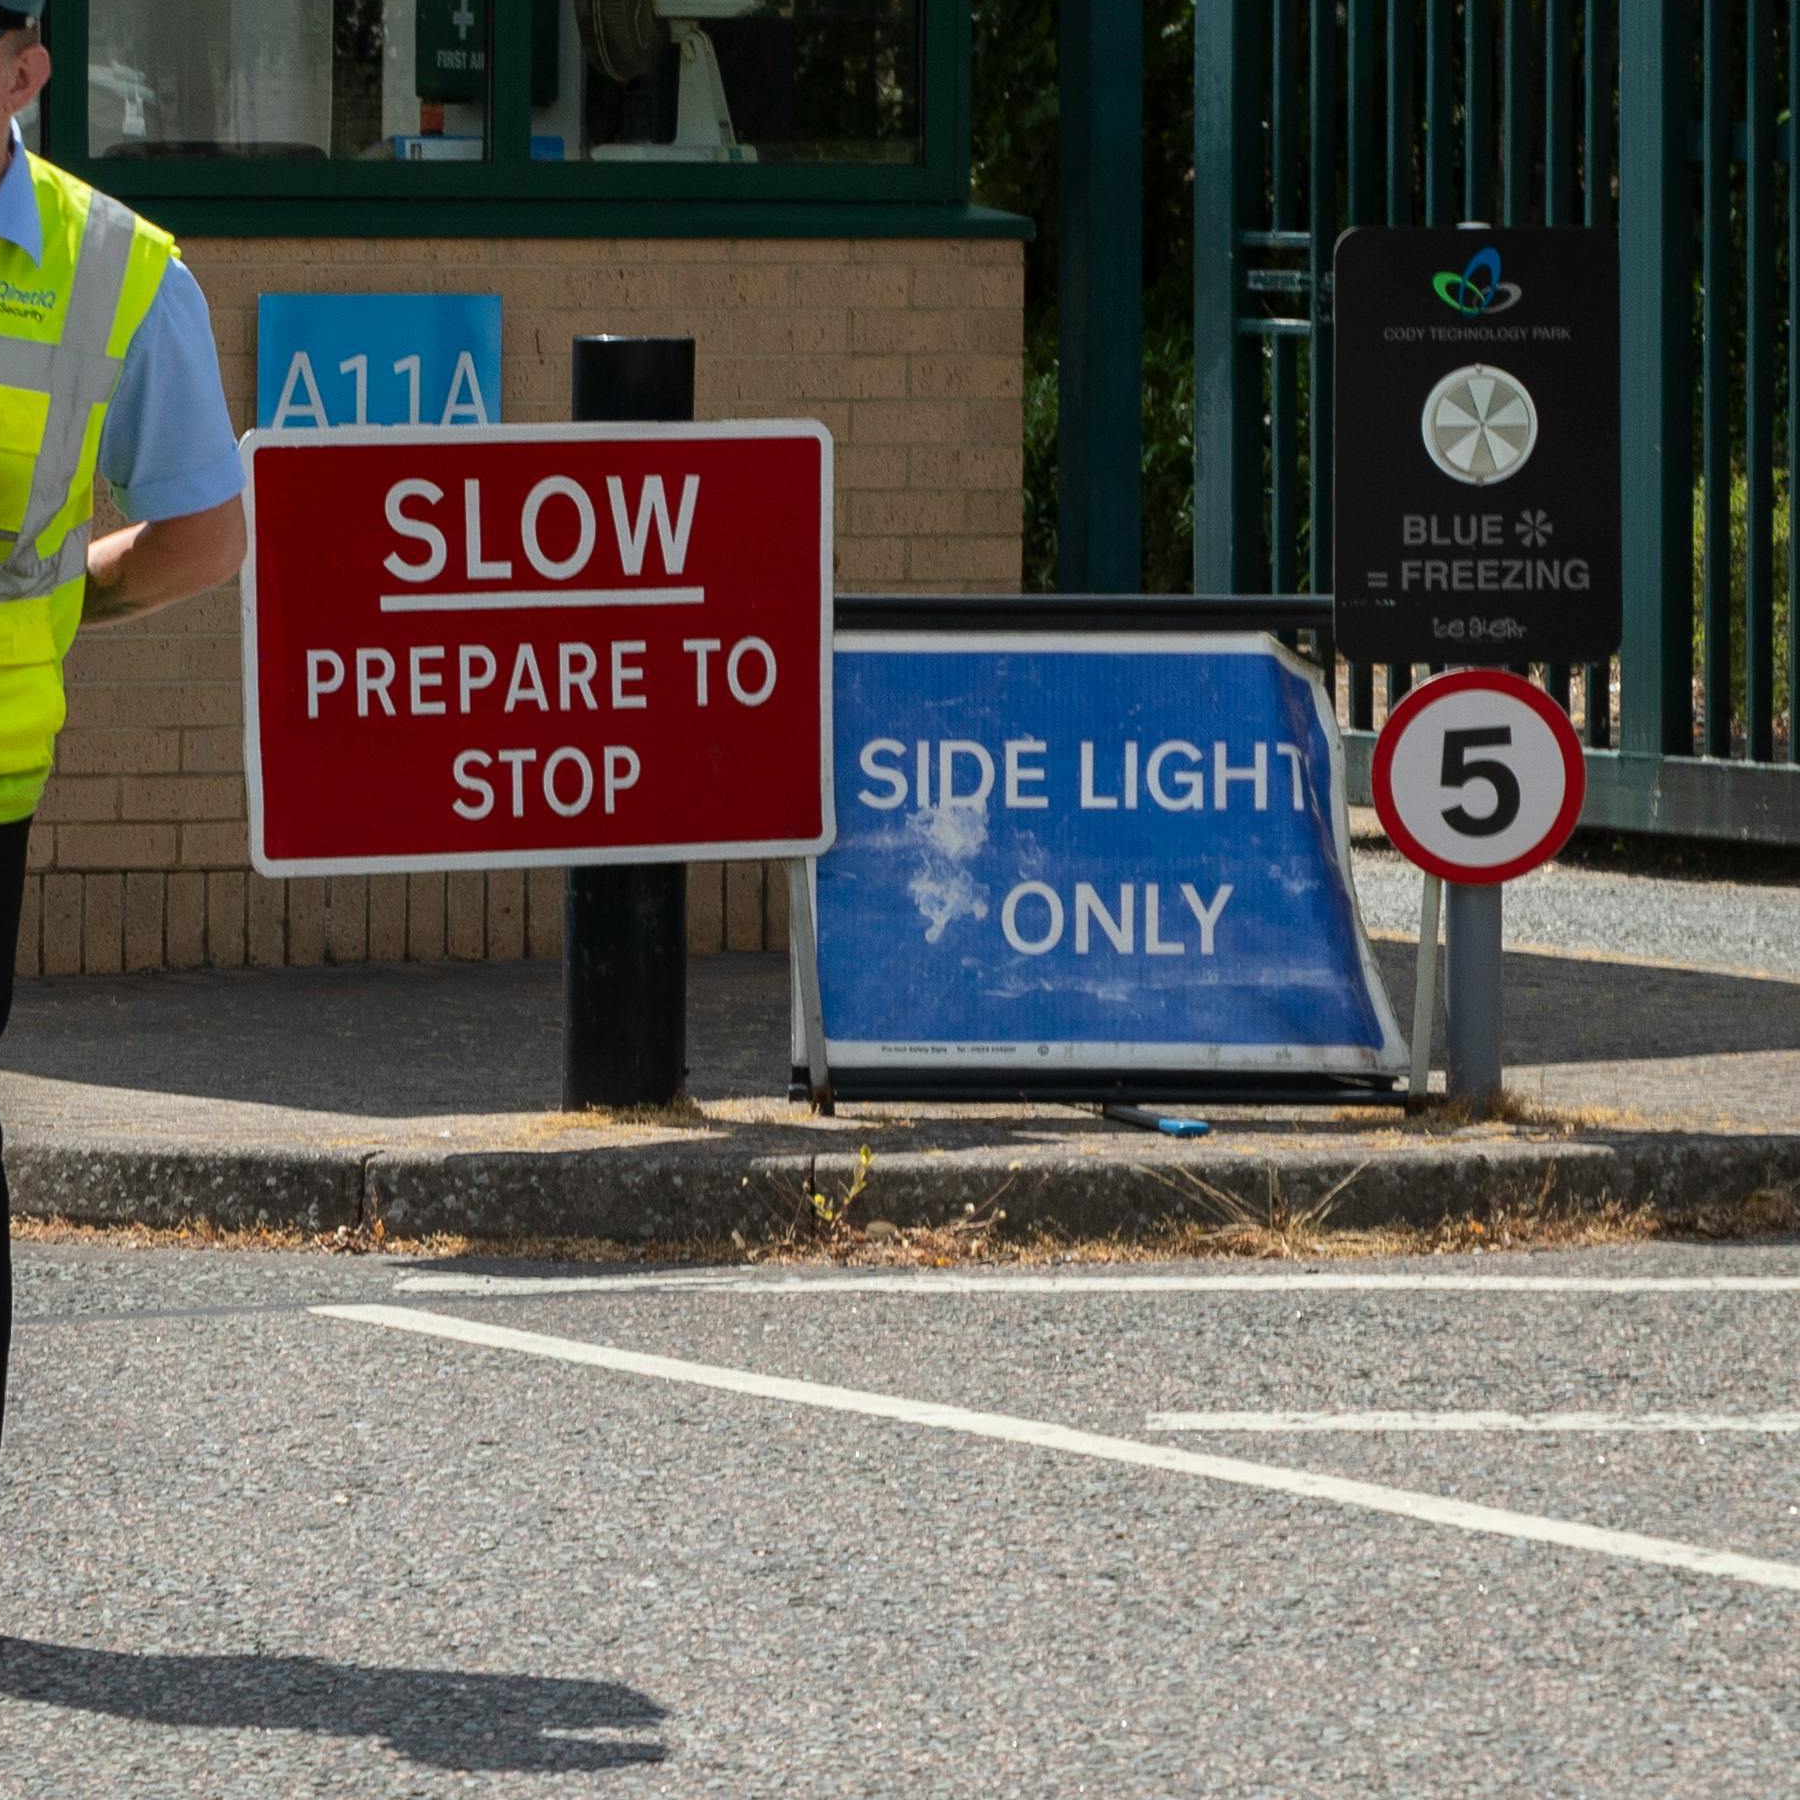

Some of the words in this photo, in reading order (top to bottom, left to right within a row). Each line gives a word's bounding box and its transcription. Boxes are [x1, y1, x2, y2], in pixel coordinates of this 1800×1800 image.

[437, 49, 467, 70] FIRST
[0, 302, 45, 324] Security
[1384, 326, 1424, 341] CODY
[1430, 326, 1528, 341] TECHNOLOGY
[1532, 326, 1571, 341] PARK
[272, 351, 489, 429] A11A
[383, 474, 700, 582] SLOW
[1403, 514, 1503, 546] BLUE
[1401, 559, 1590, 591] FREEZING
[306, 641, 648, 719] PREPARE
[683, 636, 777, 707] TO
[452, 745, 641, 820] STOP
[857, 737, 1049, 809] SIDE
[1440, 725, 1521, 838] 5
[1002, 881, 1234, 955] ONLY
